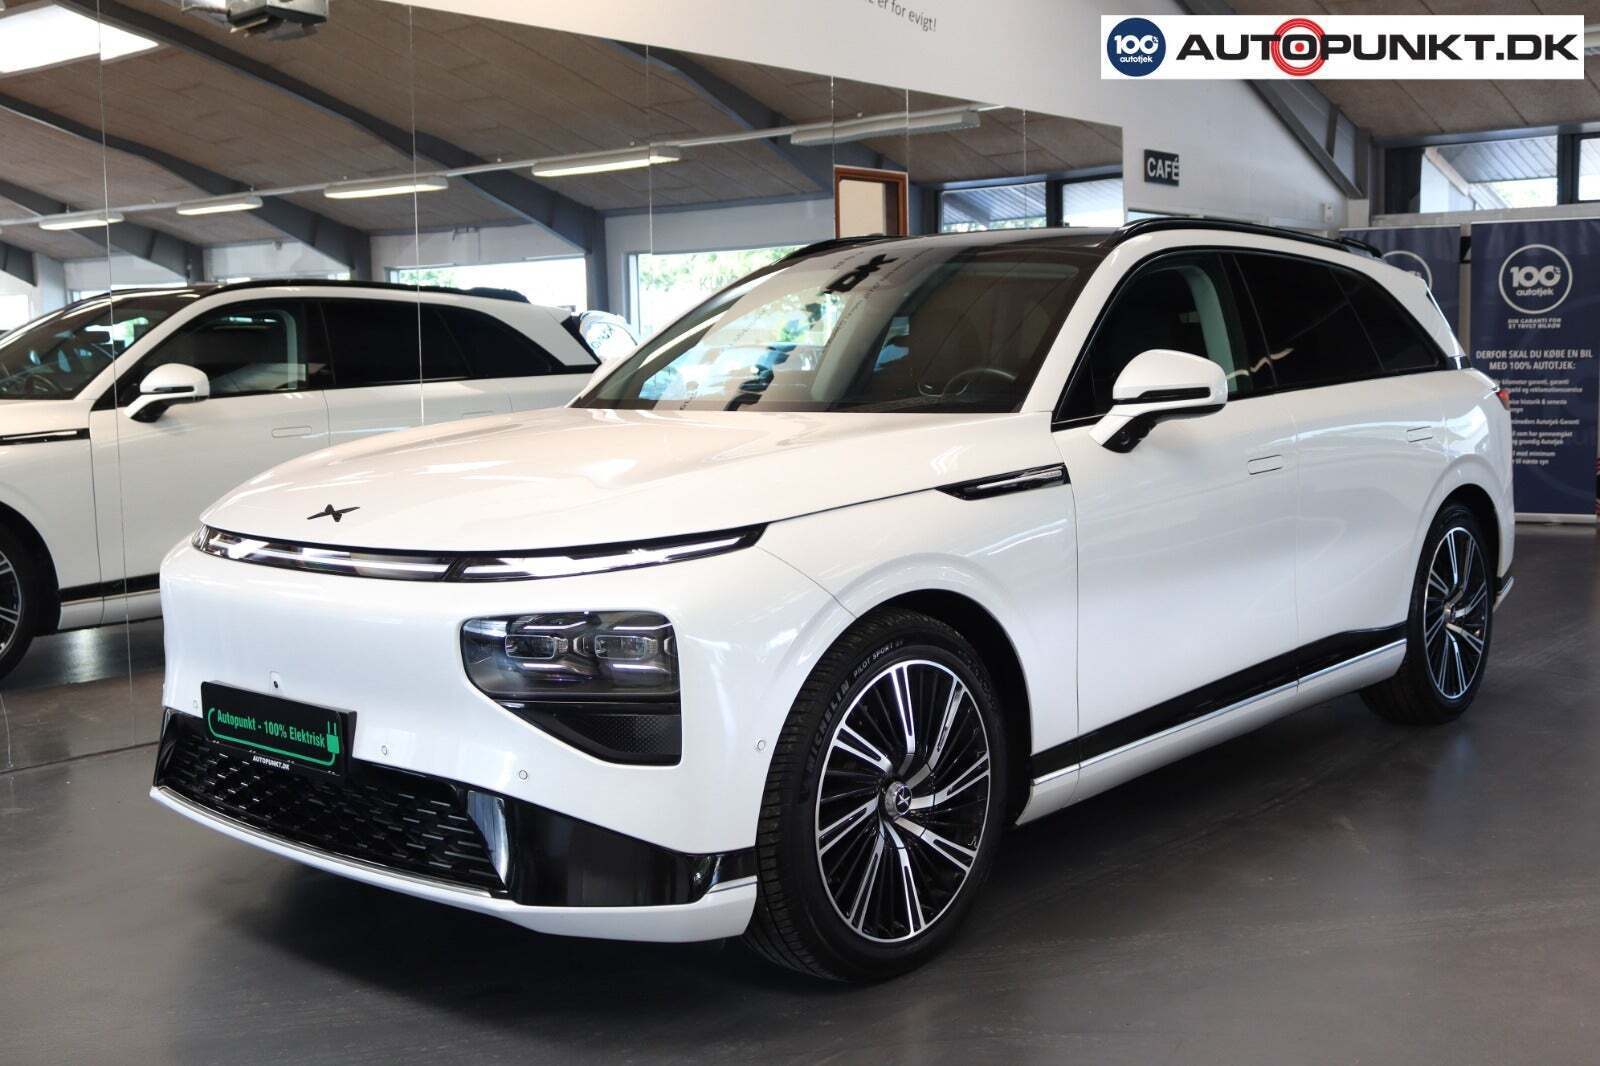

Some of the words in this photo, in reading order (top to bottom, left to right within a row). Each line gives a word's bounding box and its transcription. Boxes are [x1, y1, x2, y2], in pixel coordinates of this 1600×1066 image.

[891, 0, 906, 17] for
[908, 10, 937, 32] evigt!
[1147, 157, 1180, 180] CAFÉ
[1516, 287, 1554, 297] autotjek
[1475, 350, 1507, 359] DERFOR
[1508, 350, 1528, 359] SKAL
[1530, 349, 1542, 359] DU
[1543, 349, 1565, 358] KØBE
[1567, 349, 1578, 358] EN
[1580, 348, 1592, 358] BIL
[1489, 361, 1508, 370] MED
[1510, 361, 1531, 370] 100%
[1533, 360, 1576, 370] AUTOTJEK:
[853, 657, 872, 677] PILOT
[217, 709, 256, 730] Autopunkt
[263, 721, 288, 738] 100%
[289, 726, 326, 748] Elektrisk
